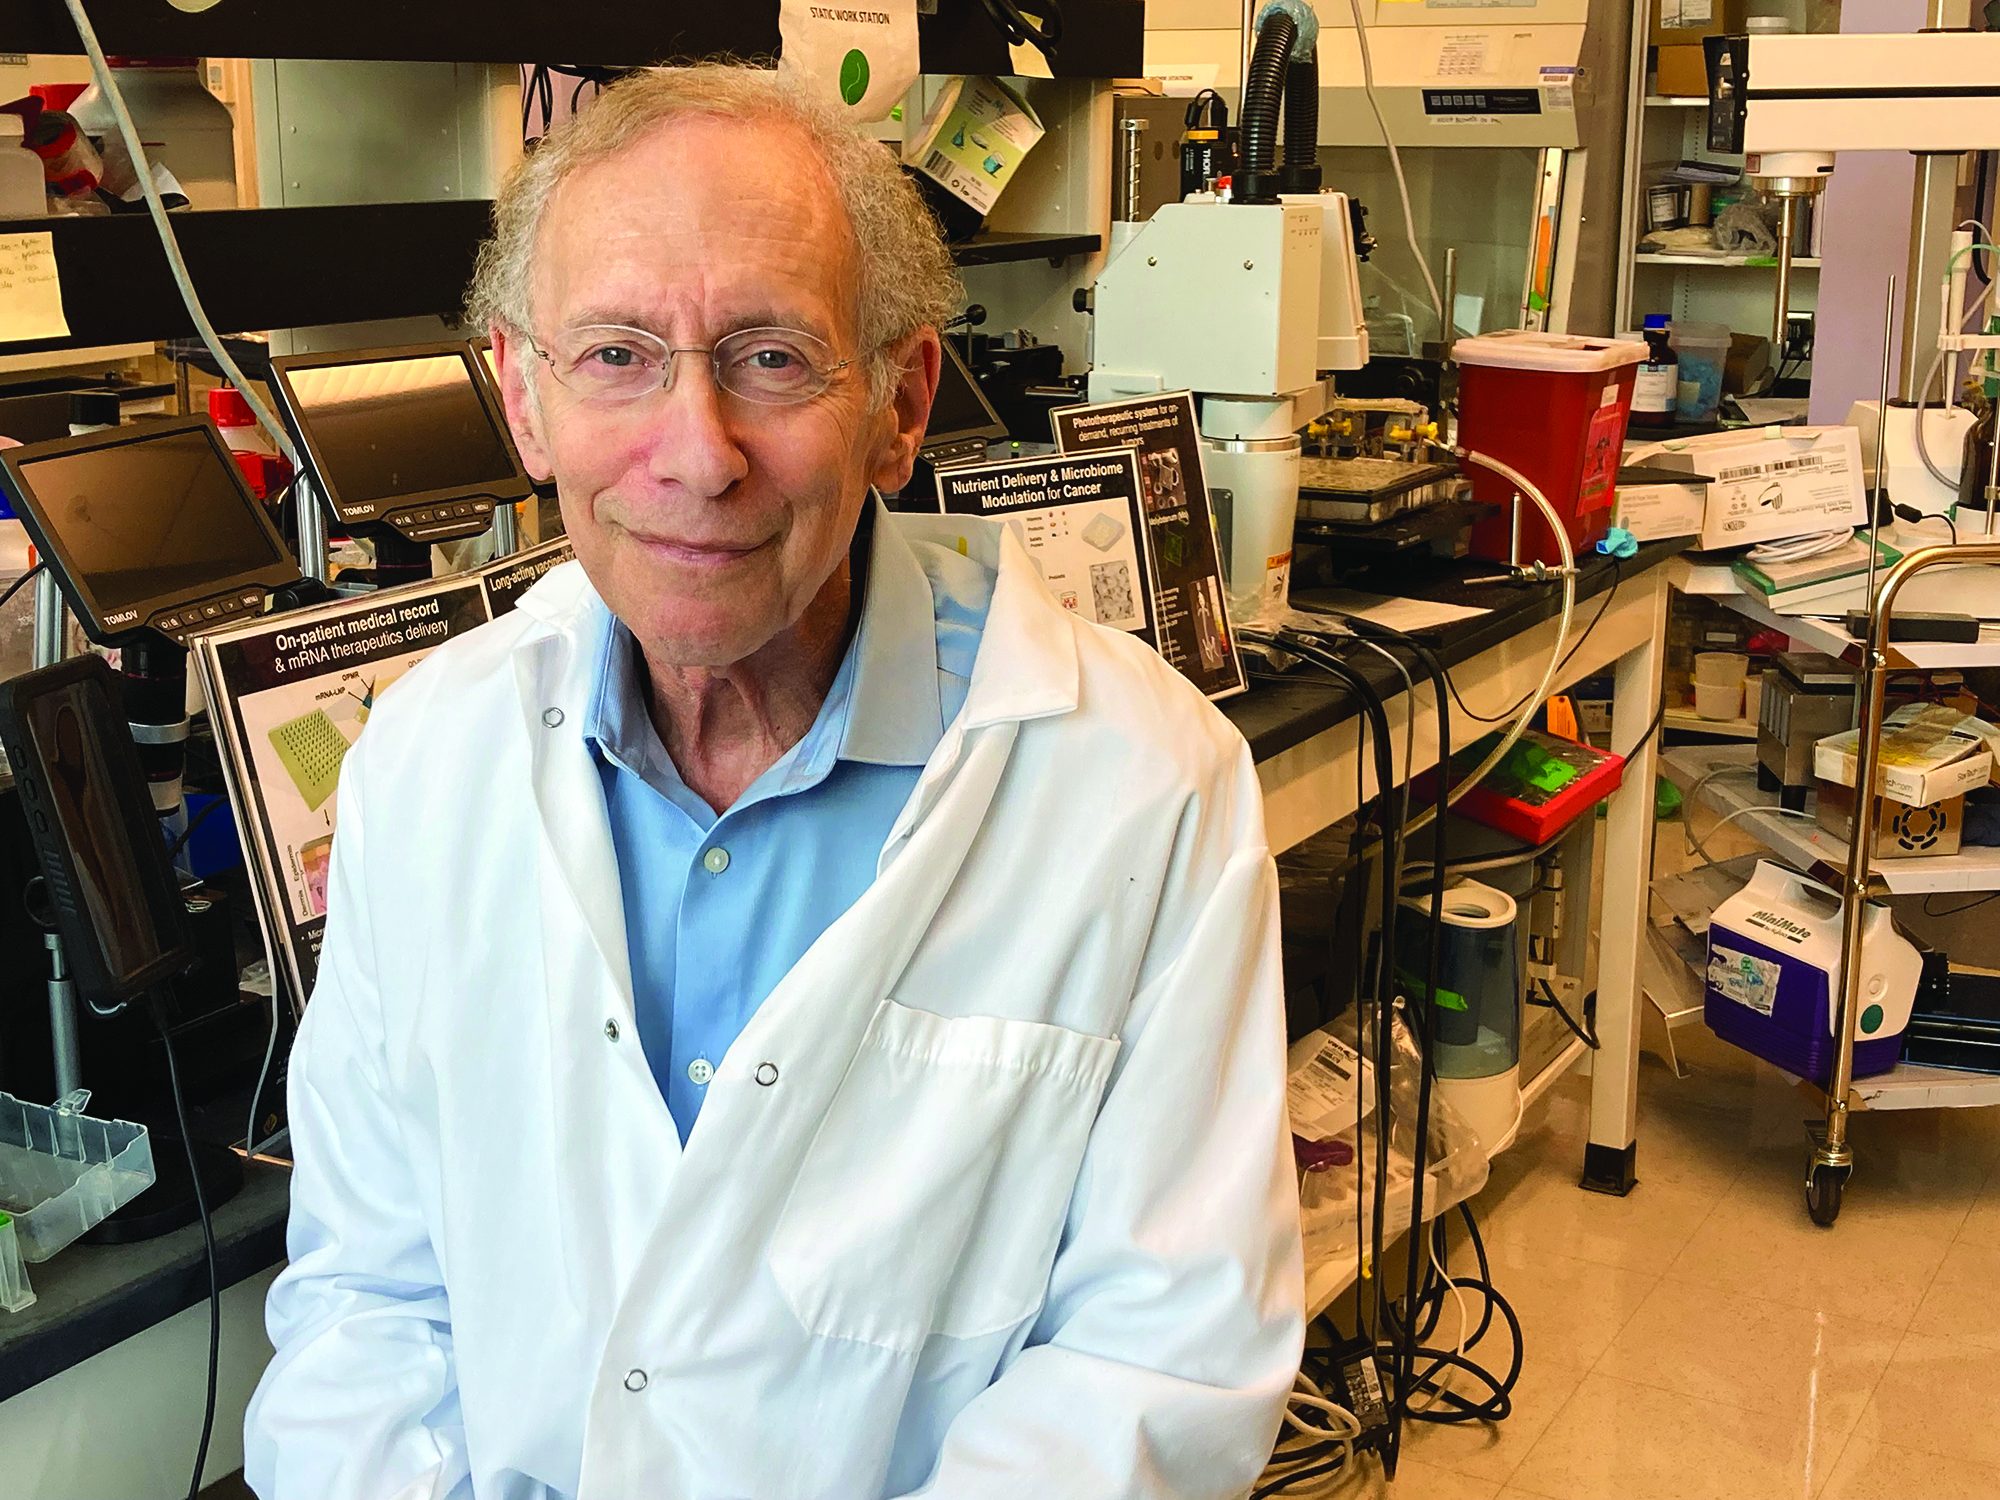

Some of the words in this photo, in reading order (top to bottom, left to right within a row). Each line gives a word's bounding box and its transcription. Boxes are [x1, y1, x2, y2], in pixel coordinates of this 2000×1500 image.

[809, 7, 835, 20] STATIC
[835, 10, 858, 22] WORK
[859, 11, 890, 24] STATION
[1072, 410, 1133, 428] Phototherapeutic
[1134, 406, 1158, 420] system
[1159, 404, 1168, 414] for
[1078, 428, 1109, 442] demand,
[1109, 424, 1138, 436] recurring
[1138, 418, 1171, 431] treatments
[1171, 415, 1178, 426] of
[952, 476, 1001, 495] Nutrient
[1002, 472, 1047, 489] Delivery
[1050, 469, 1059, 482] &
[1061, 463, 1124, 481] Microbiome
[474, 503, 489, 511] MENU
[982, 489, 1045, 509] Modulation
[1047, 487, 1061, 500] for
[1063, 483, 1102, 498] Cancer
[342, 504, 375, 517] TOMLOV
[489, 565, 536, 592] Long-acting
[243, 594, 258, 605] MENU
[103, 610, 138, 626] TOMLOV
[276, 620, 346, 650] On-patient
[348, 608, 397, 634] medical
[400, 599, 439, 622] record
[275, 657, 286, 673] &
[288, 646, 330, 670] mRNA
[331, 630, 404, 660] therapeutics
[405, 619, 448, 642] delivery
[1752, 911, 1811, 938] MiniMate
